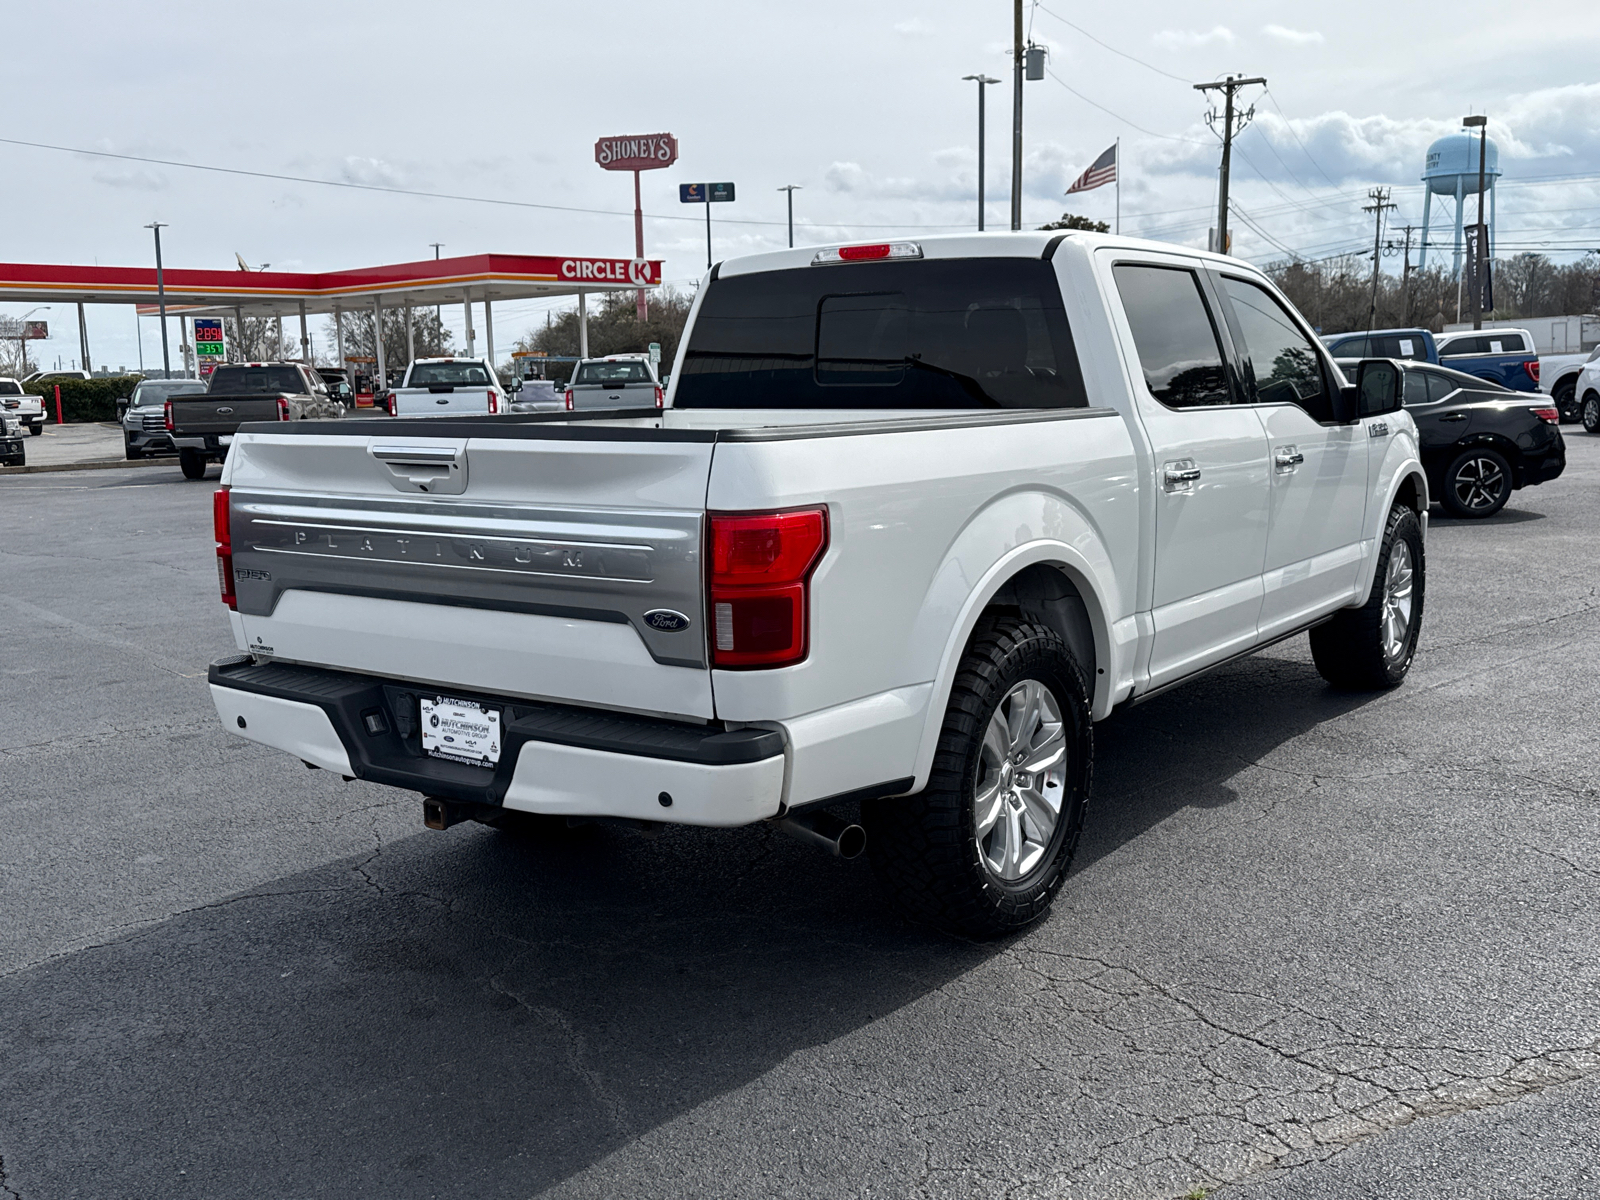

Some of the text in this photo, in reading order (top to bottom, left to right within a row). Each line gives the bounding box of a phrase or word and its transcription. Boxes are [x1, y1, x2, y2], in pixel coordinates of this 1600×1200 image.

[599, 136, 671, 164] SHONEY'S
[561, 259, 650, 281] CIRCLE K
[294, 531, 584, 567] PLATINUM
[652, 613, 678, 628] Ford
[443, 697, 480, 709] HUTCHINSON
[441, 718, 490, 733] HUTCHINSON
[442, 728, 471, 737] AUTOMOTIVE
[428, 750, 494, 768] Hutchinsonautogroup.com
